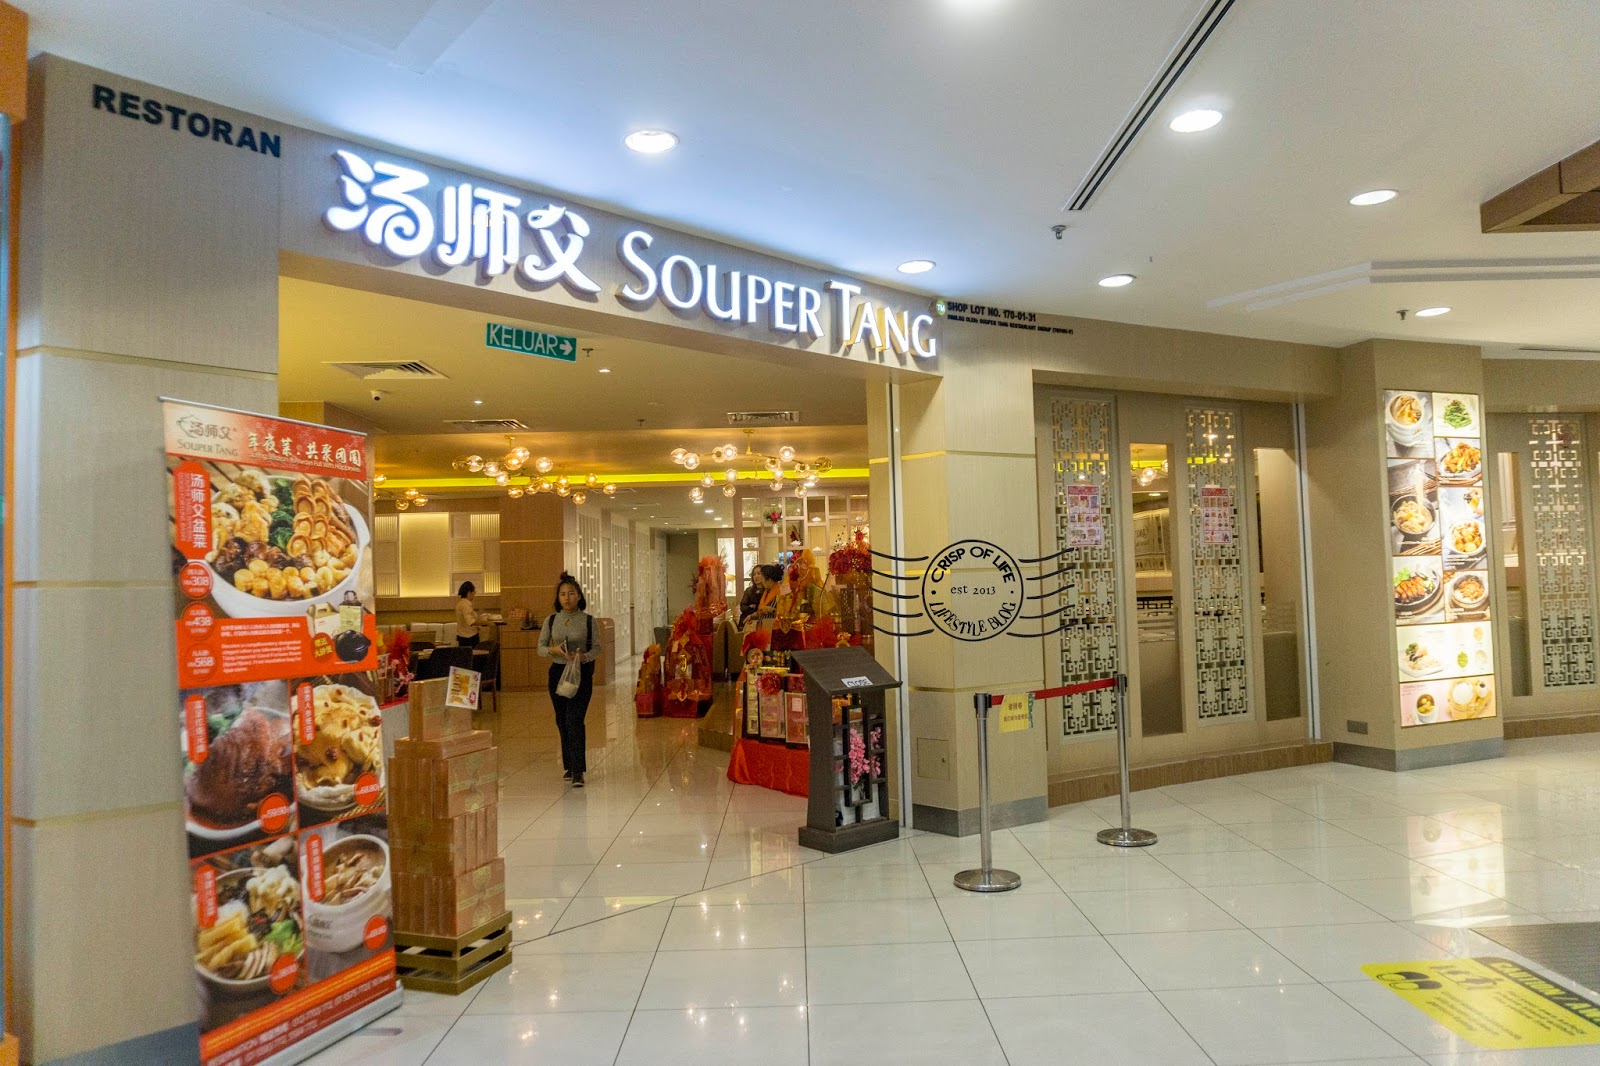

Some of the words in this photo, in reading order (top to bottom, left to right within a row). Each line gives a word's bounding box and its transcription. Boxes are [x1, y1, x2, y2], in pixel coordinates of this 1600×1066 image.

[92, 83, 281, 158] RESTORAN
[323, 148, 603, 294] 汤师父
[619, 229, 826, 339] SOUPER
[829, 279, 937, 358] TANG
[947, 301, 968, 313] SHOP
[970, 304, 985, 315] LOT
[988, 307, 1001, 318] NO.
[1003, 309, 1036, 322] 170-01-31
[489, 323, 559, 356] KELUAR
[177, 438, 213, 454] SOUPER
[215, 443, 239, 457] TANG
